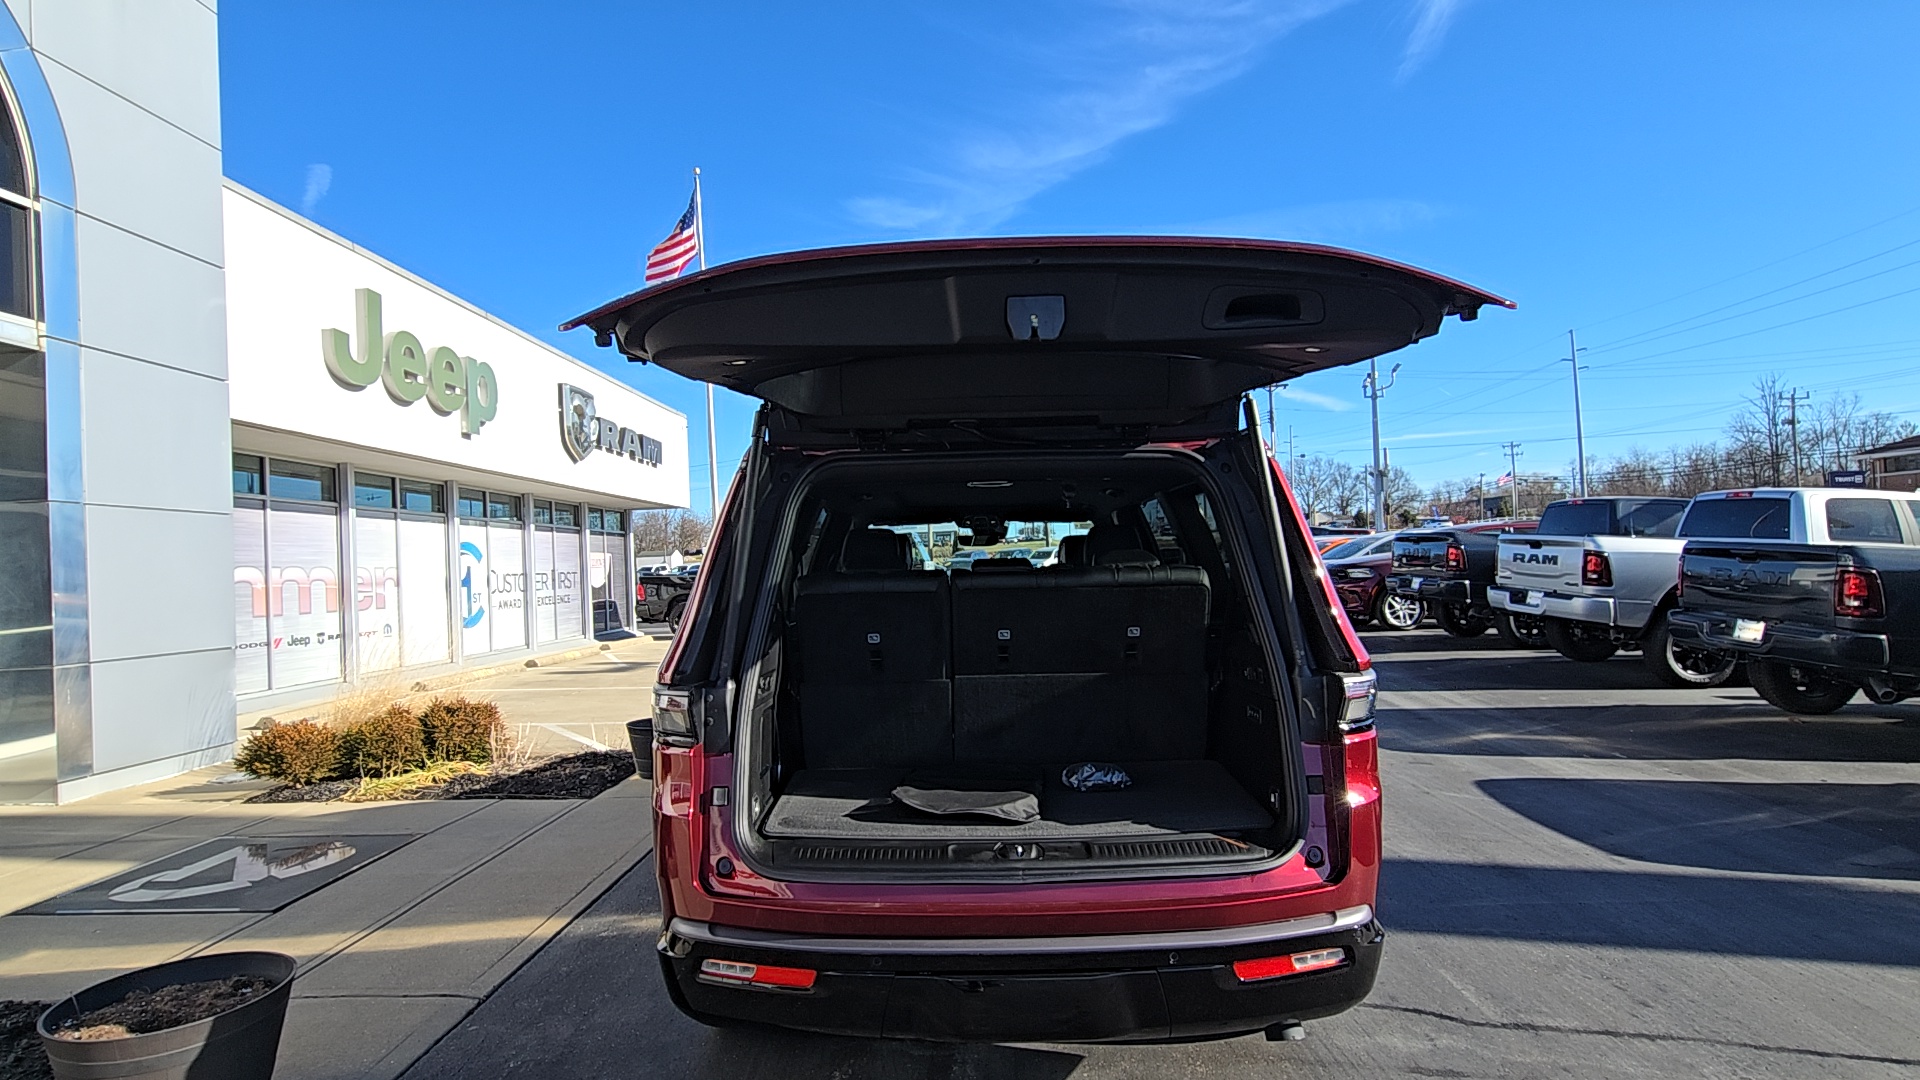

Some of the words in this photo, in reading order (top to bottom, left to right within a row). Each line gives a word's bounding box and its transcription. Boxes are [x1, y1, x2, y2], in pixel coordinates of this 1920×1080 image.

[321, 287, 498, 440] Jeep
[594, 416, 663, 468] RAM
[1512, 553, 1559, 566] RAM
[487, 570, 549, 594] CUSTOER
[1709, 566, 1792, 586] RAM
[498, 599, 522, 610] AWARD
[537, 594, 571, 606] EXCELENCE
[234, 641, 269, 650] ODG
[287, 635, 310, 647] Jeep
